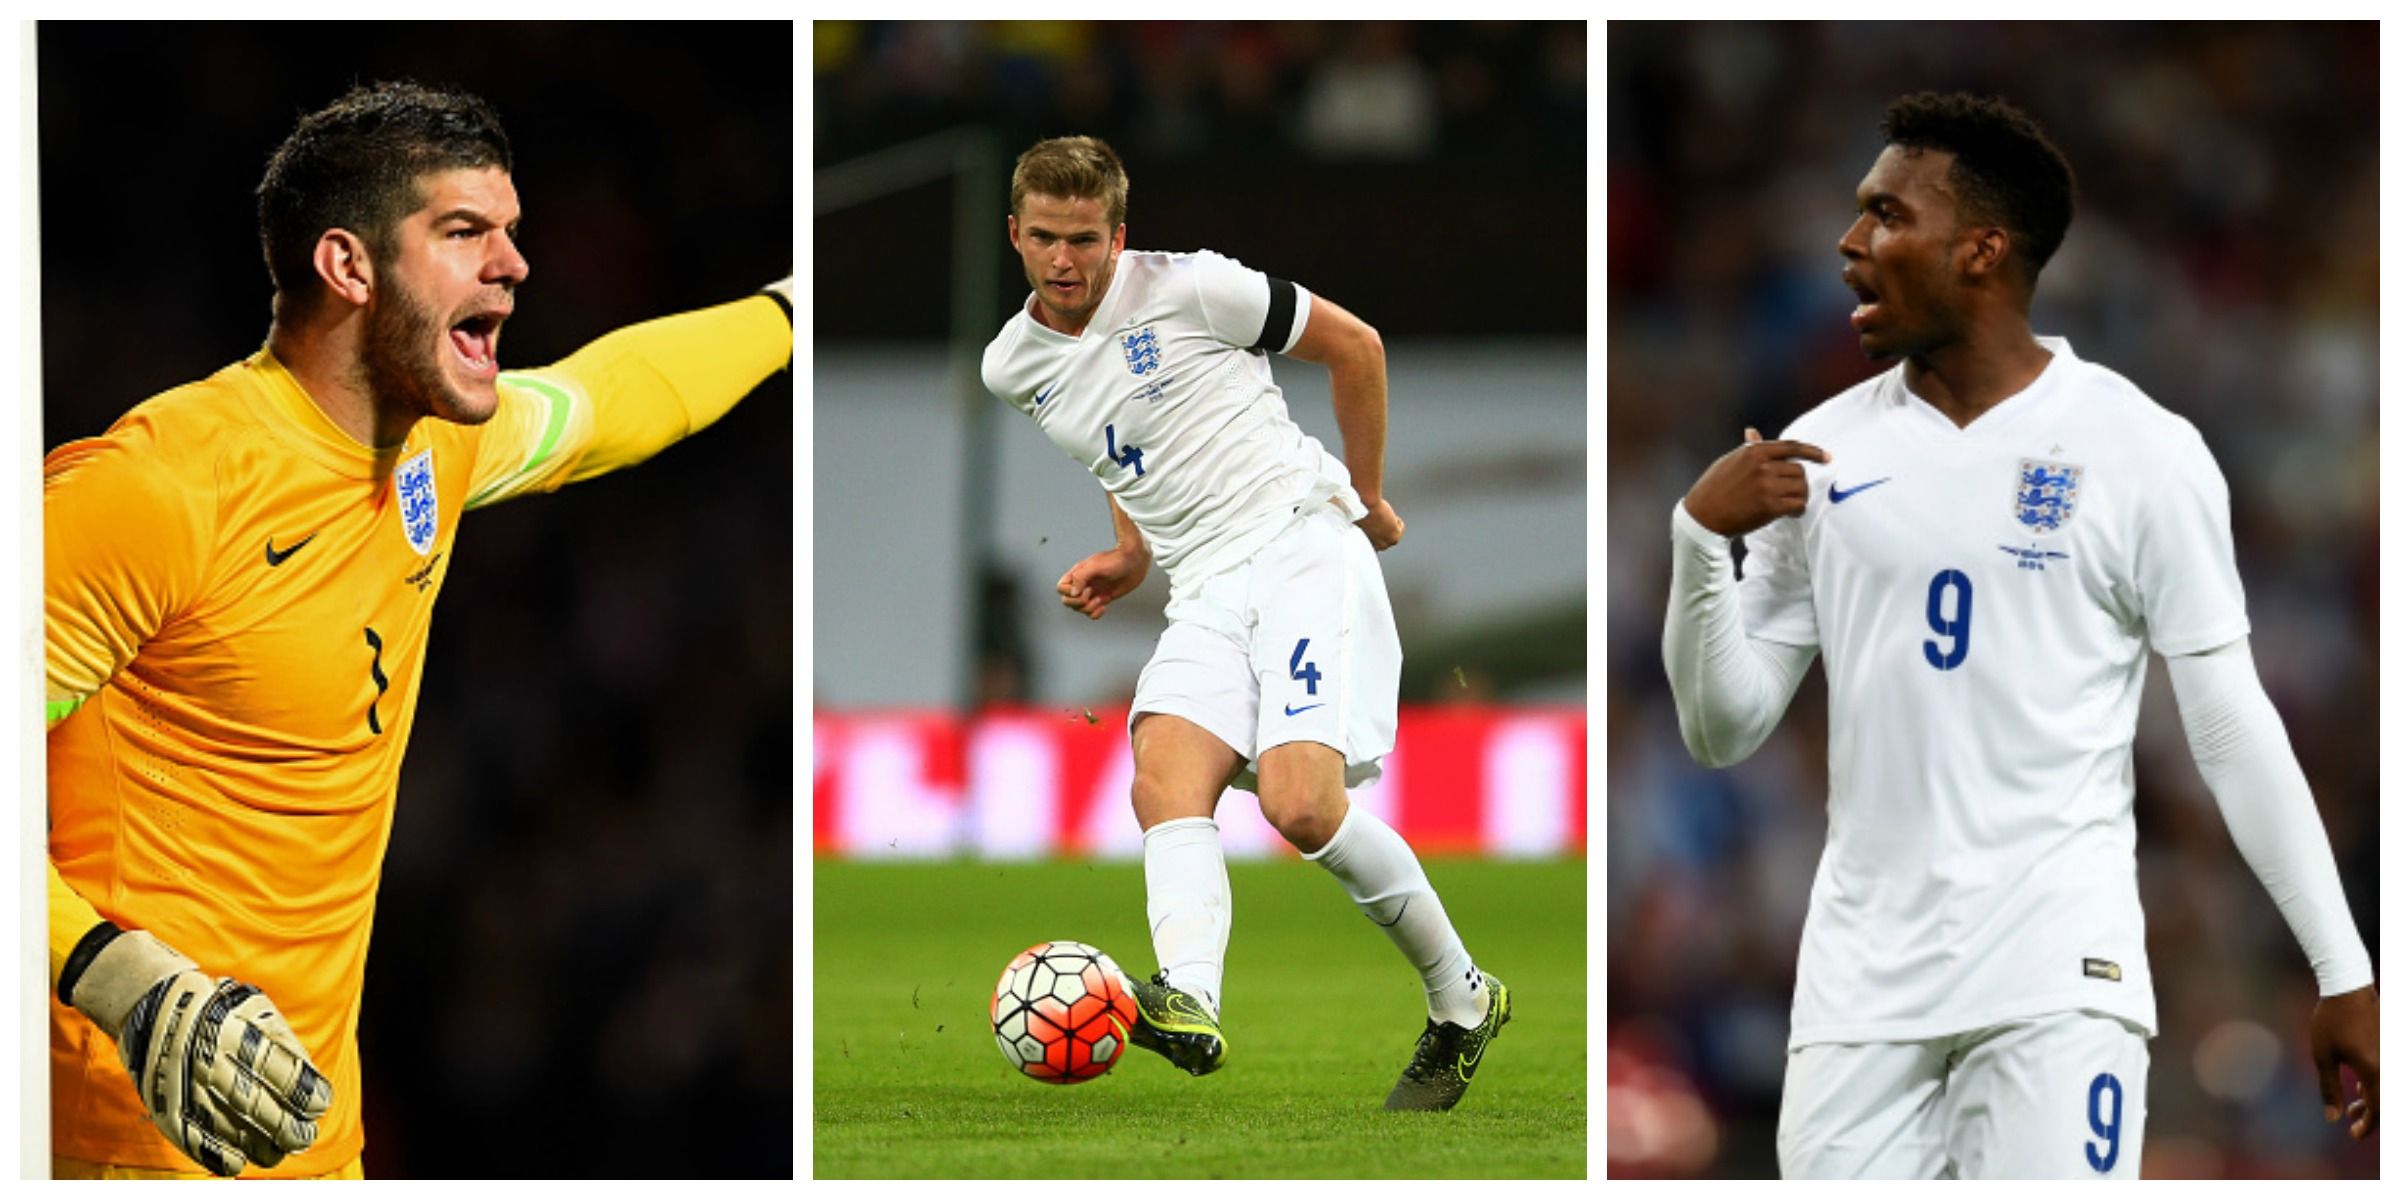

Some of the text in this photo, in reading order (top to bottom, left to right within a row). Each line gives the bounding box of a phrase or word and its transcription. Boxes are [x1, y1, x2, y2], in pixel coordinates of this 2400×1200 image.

[1105, 424, 1146, 477] 4
[1290, 639, 1321, 695] 4
[1923, 569, 1973, 671] 9
[365, 628, 387, 734] 1
[2085, 1073, 2122, 1172] 9
